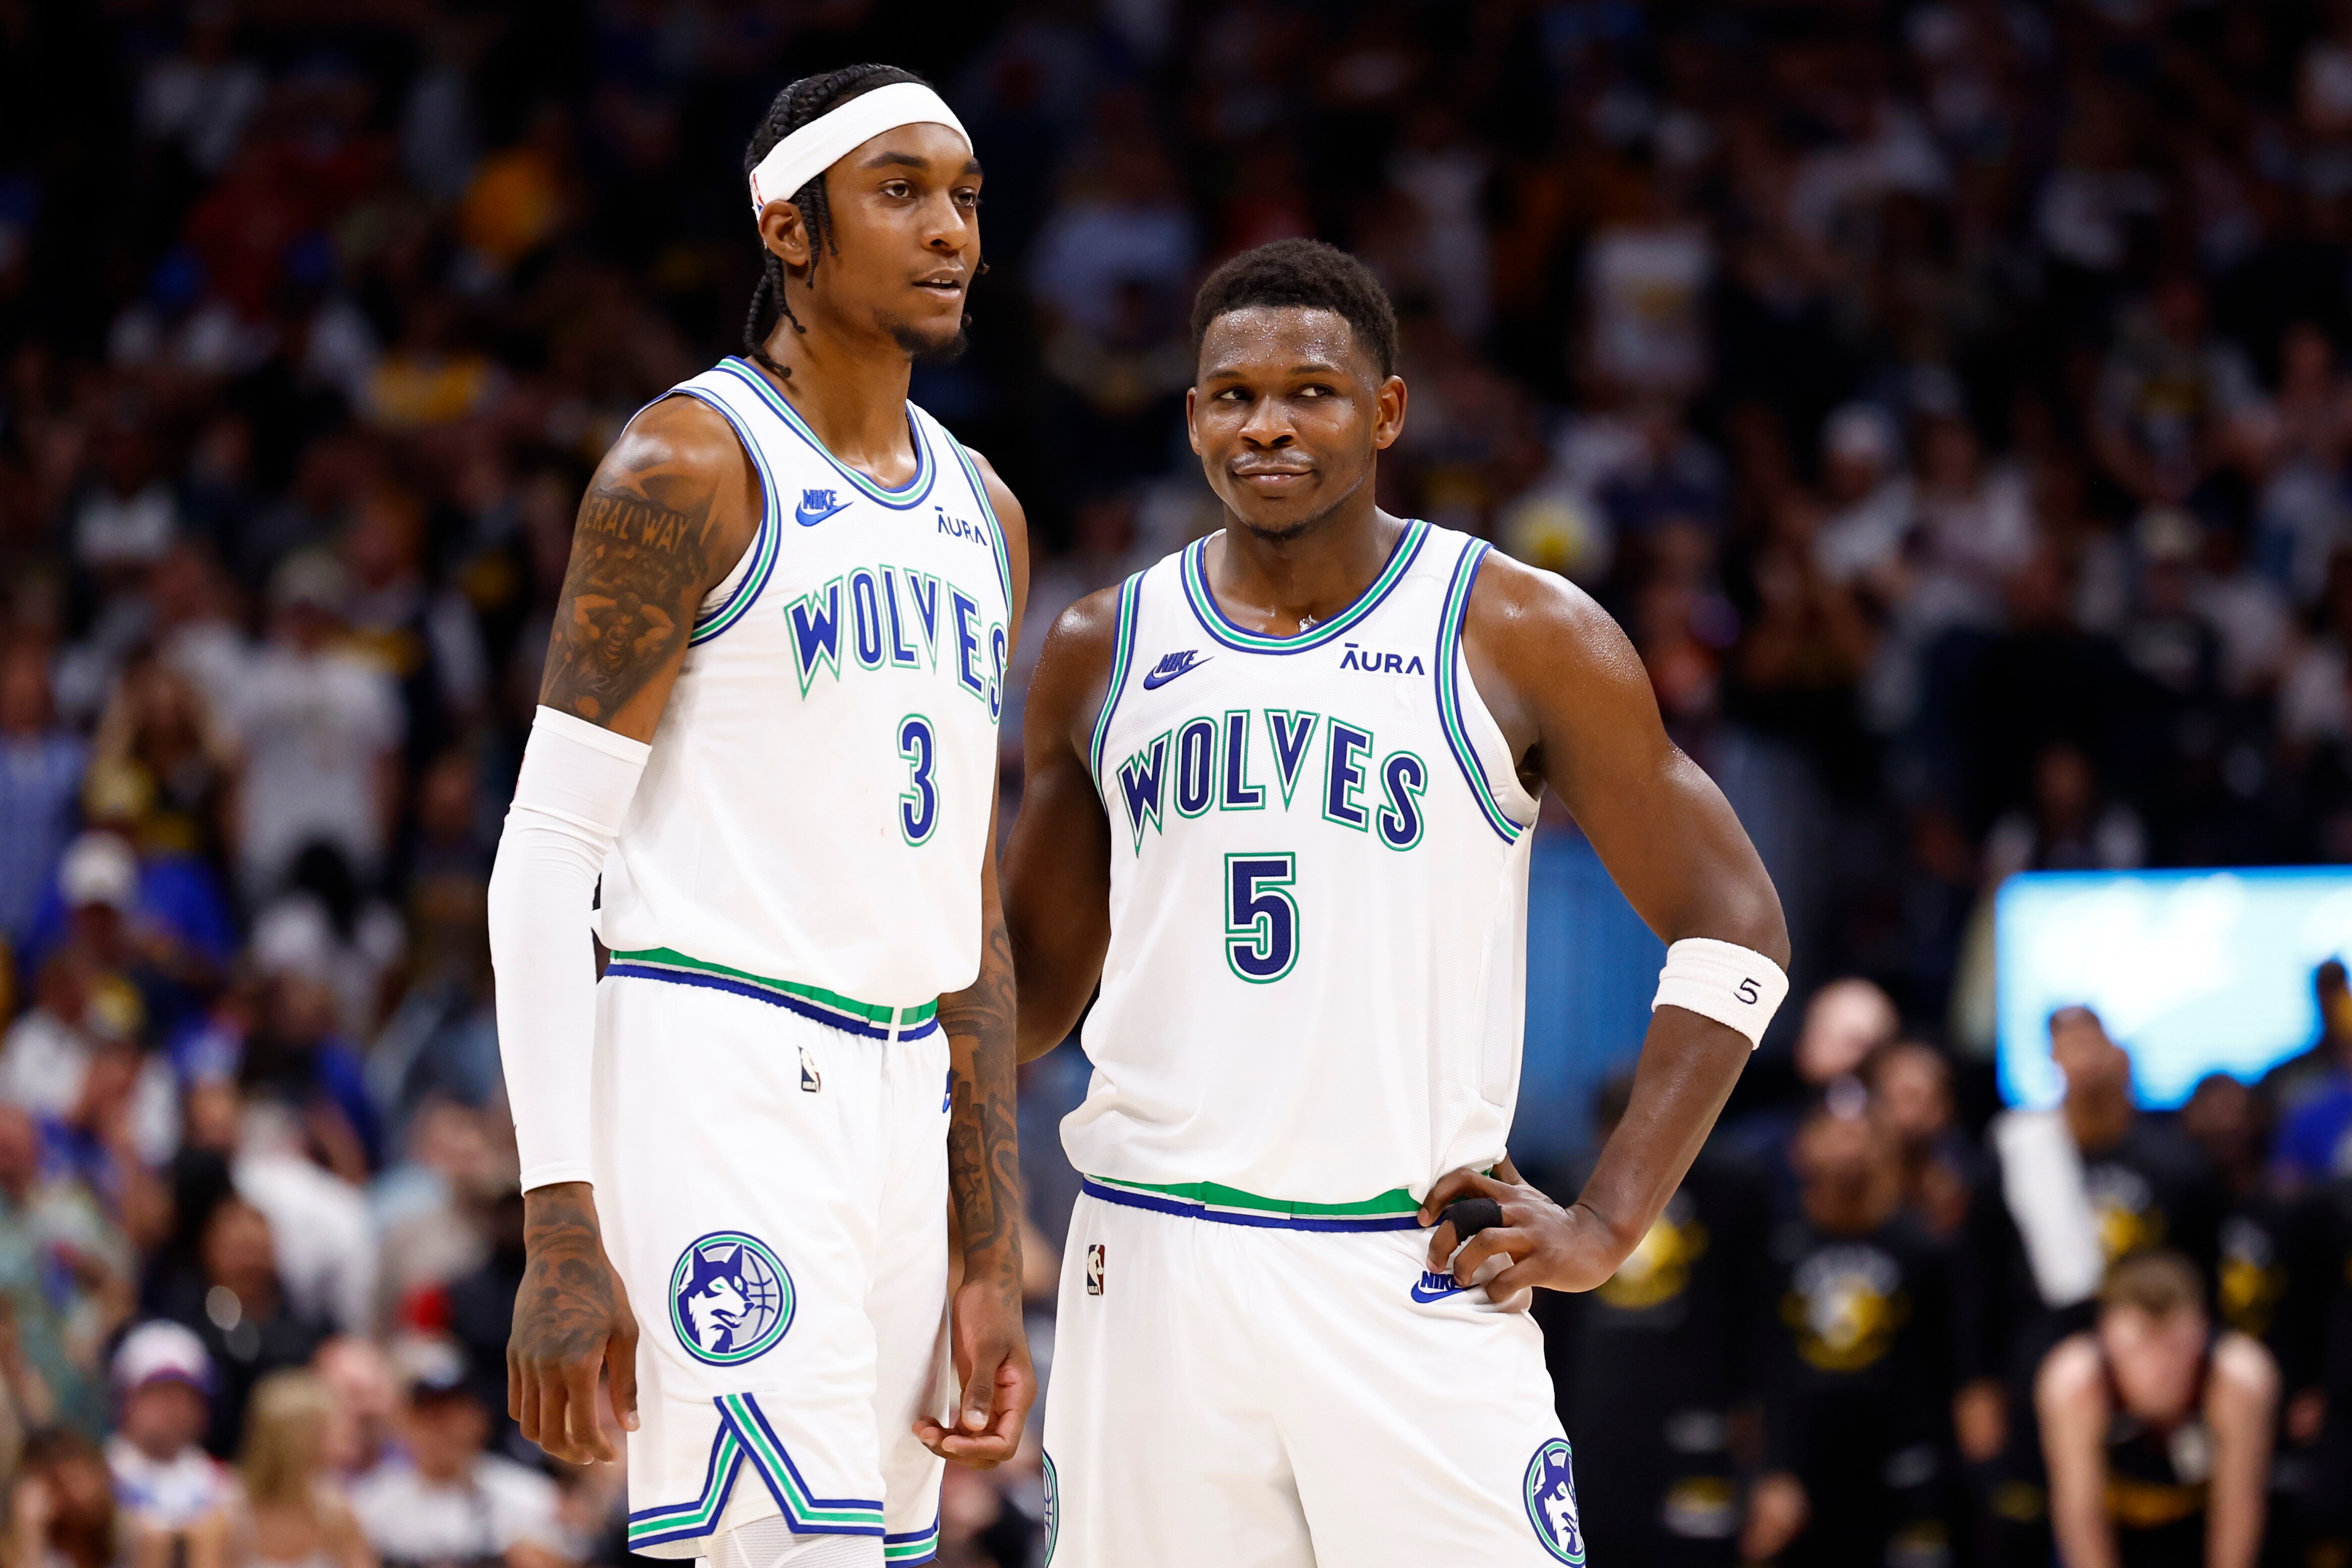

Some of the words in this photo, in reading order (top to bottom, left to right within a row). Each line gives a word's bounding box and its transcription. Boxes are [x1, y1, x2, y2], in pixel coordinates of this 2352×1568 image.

[803, 489, 837, 511] NIKE
[641, 508, 691, 554] WAY
[784, 564, 1008, 725] WOLVES
[1155, 649, 1198, 674] NIKE
[897, 714, 939, 847] 3
[1116, 709, 1428, 858] WOLVES
[1225, 852, 1299, 984] 5
[1733, 977, 1761, 1004] 5
[1088, 1285, 1099, 1293] NBA
